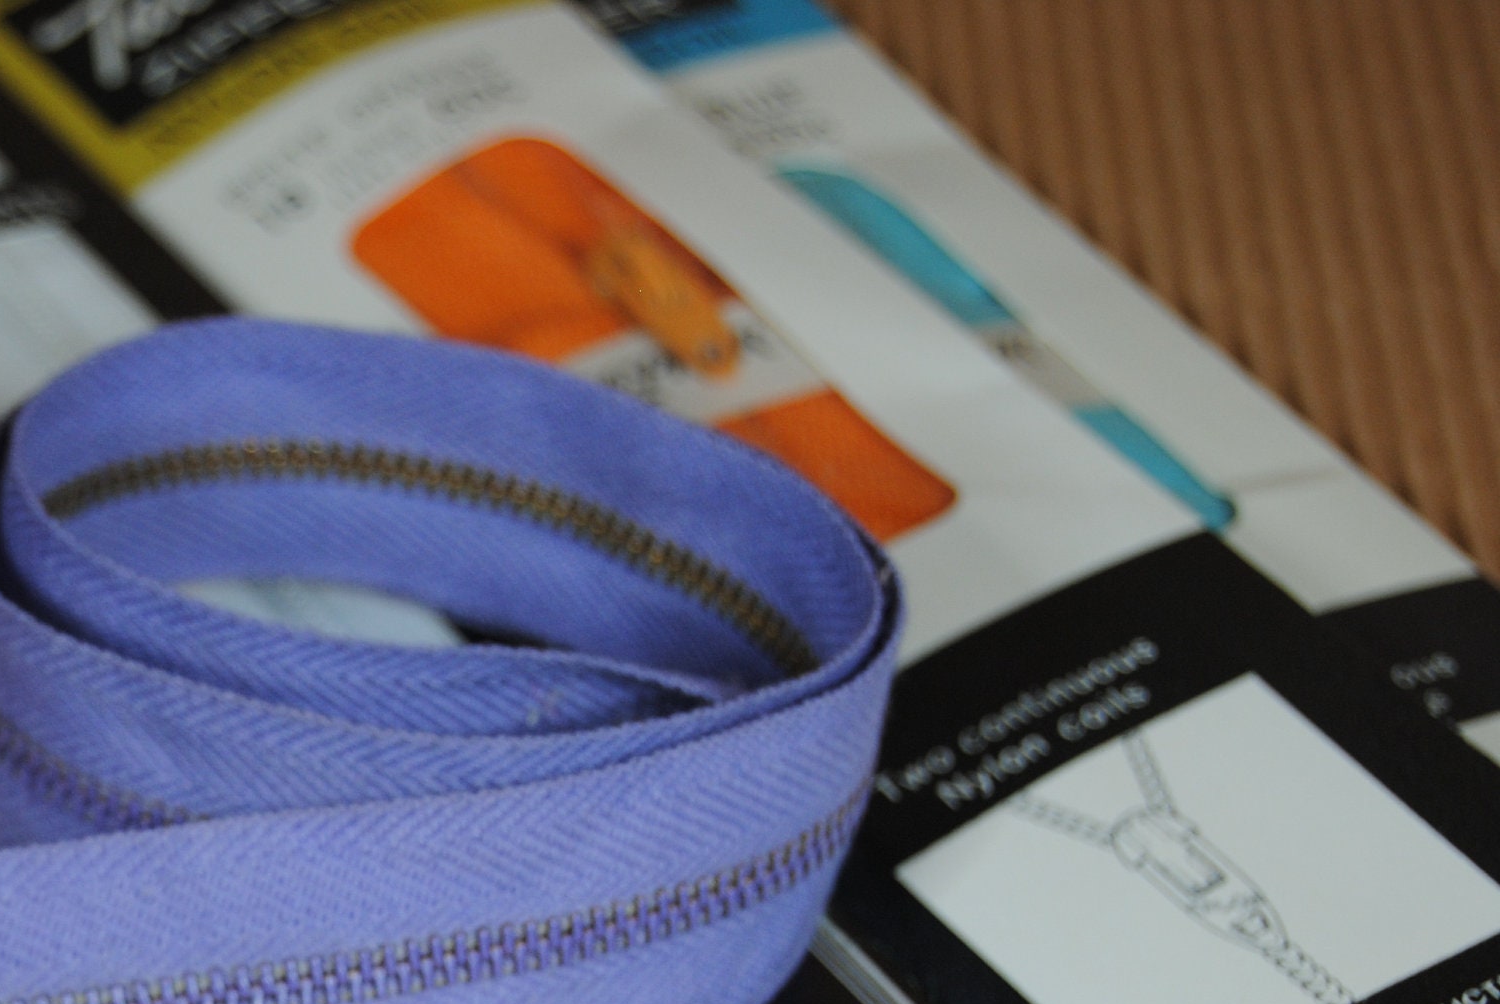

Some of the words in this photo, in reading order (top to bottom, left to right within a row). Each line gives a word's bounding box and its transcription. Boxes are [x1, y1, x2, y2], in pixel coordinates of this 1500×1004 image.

[875, 746, 957, 804] Two
[956, 636, 1159, 756] continuous
[936, 733, 1051, 811] Nylon
[1056, 682, 1151, 741] coils
